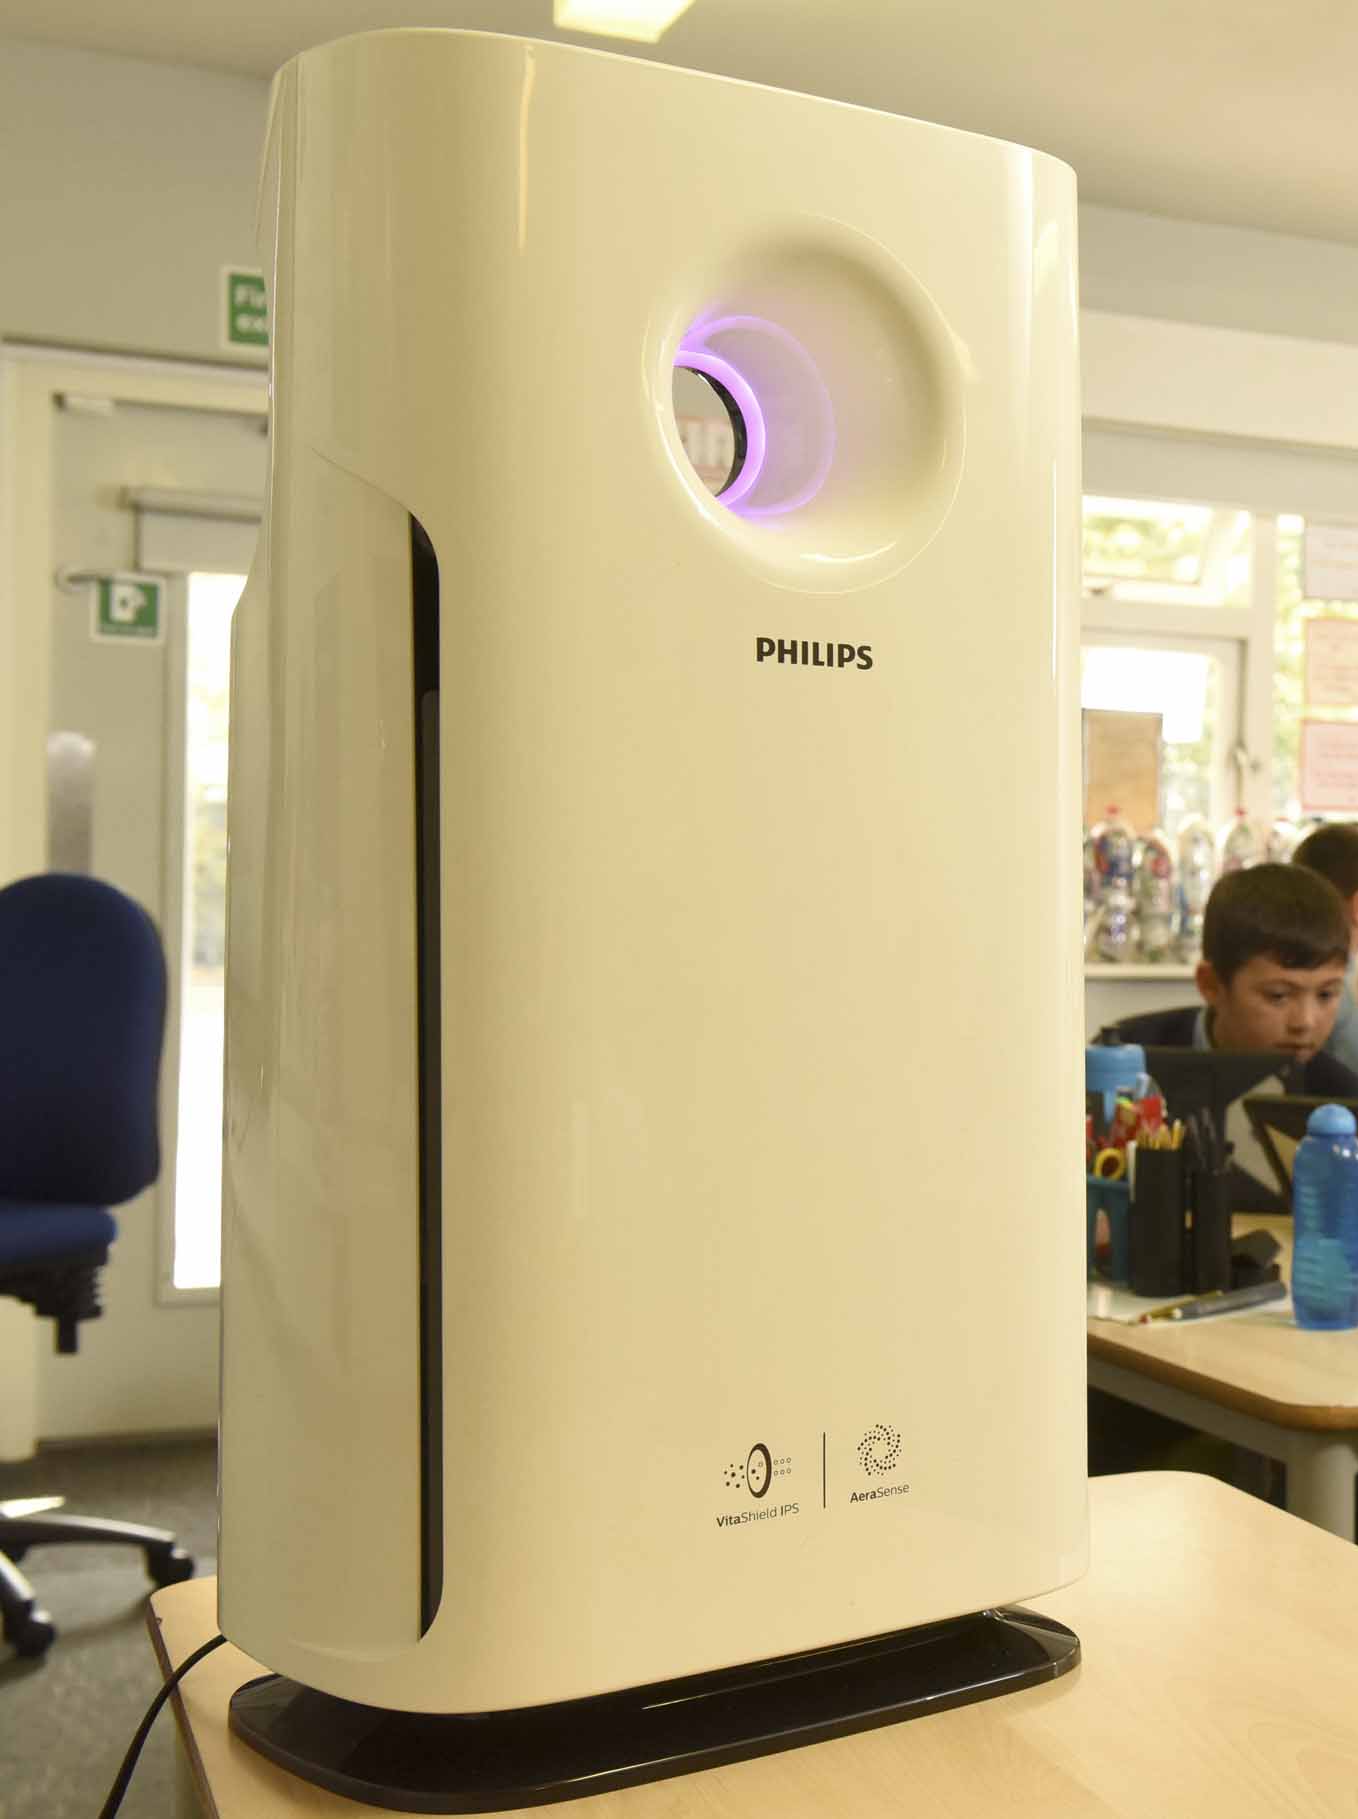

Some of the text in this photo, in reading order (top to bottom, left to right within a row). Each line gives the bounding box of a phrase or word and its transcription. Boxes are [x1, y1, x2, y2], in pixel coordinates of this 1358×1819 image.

[756, 637, 873, 670] PHILIPS
[849, 1482, 910, 1503] AeraSense
[716, 1503, 800, 1528] VitaShield IPS
